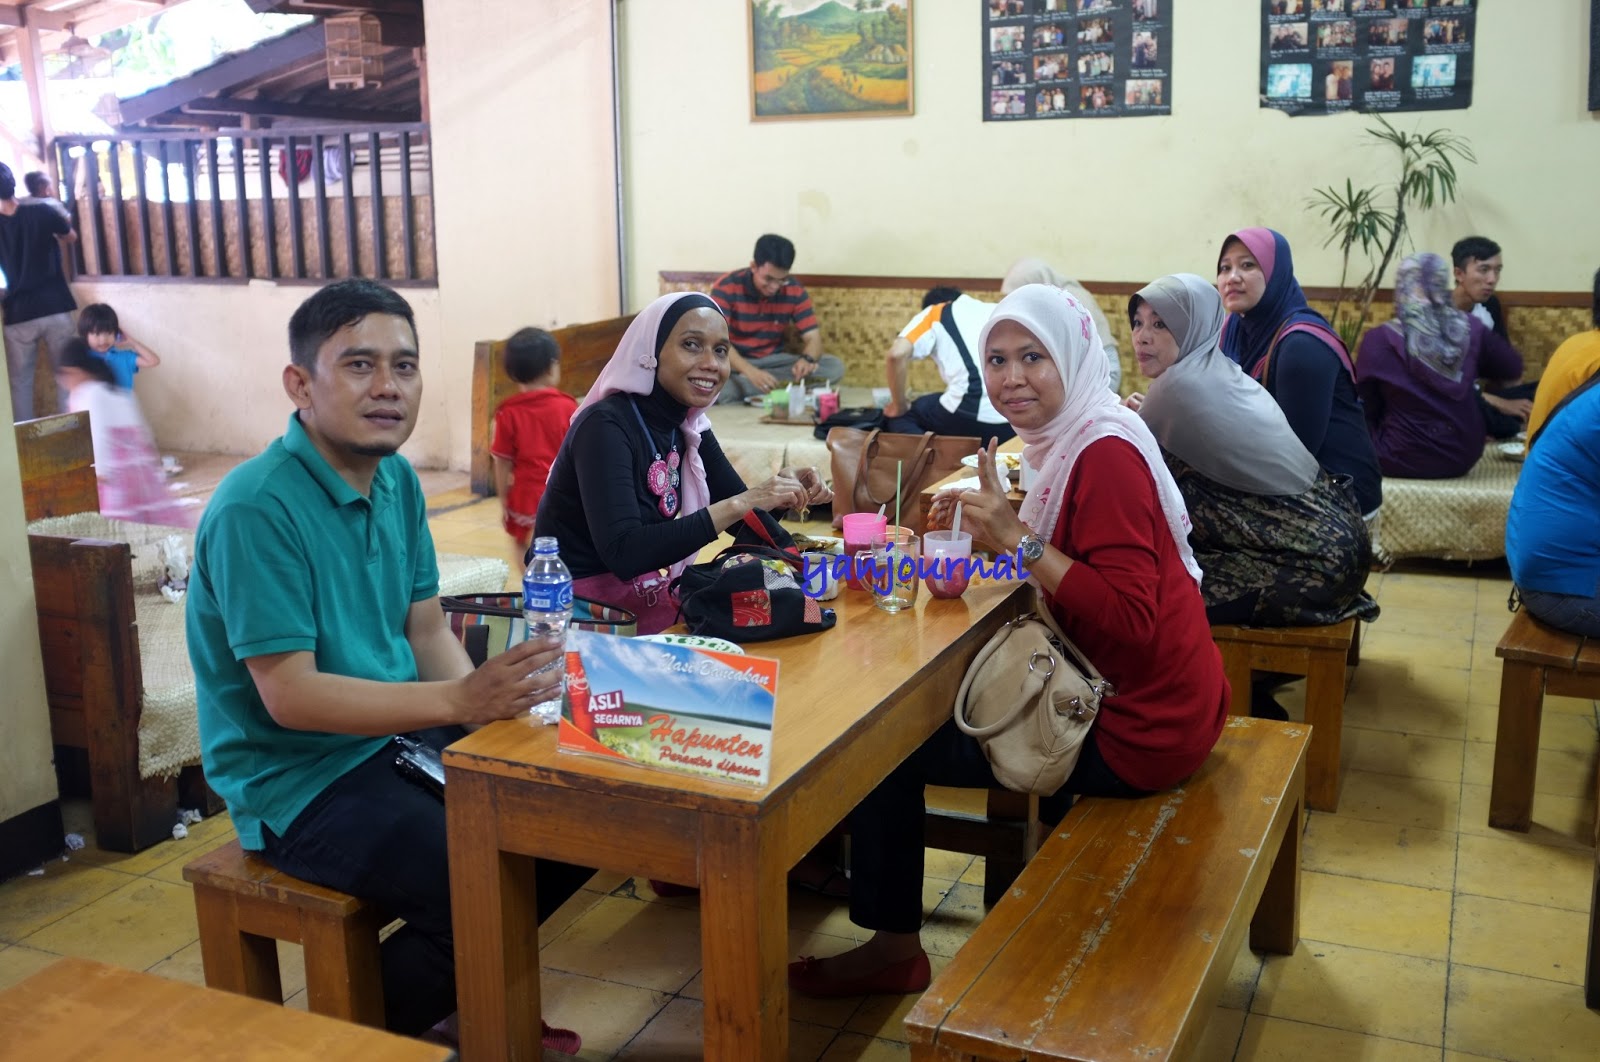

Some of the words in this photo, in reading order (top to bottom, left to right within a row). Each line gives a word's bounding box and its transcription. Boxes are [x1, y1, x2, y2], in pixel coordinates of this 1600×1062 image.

[660, 652, 694, 674] Nasi
[588, 692, 621, 713] ASLI
[593, 713, 643, 726] SEGARNYA
[647, 713, 764, 759] Hapunten
